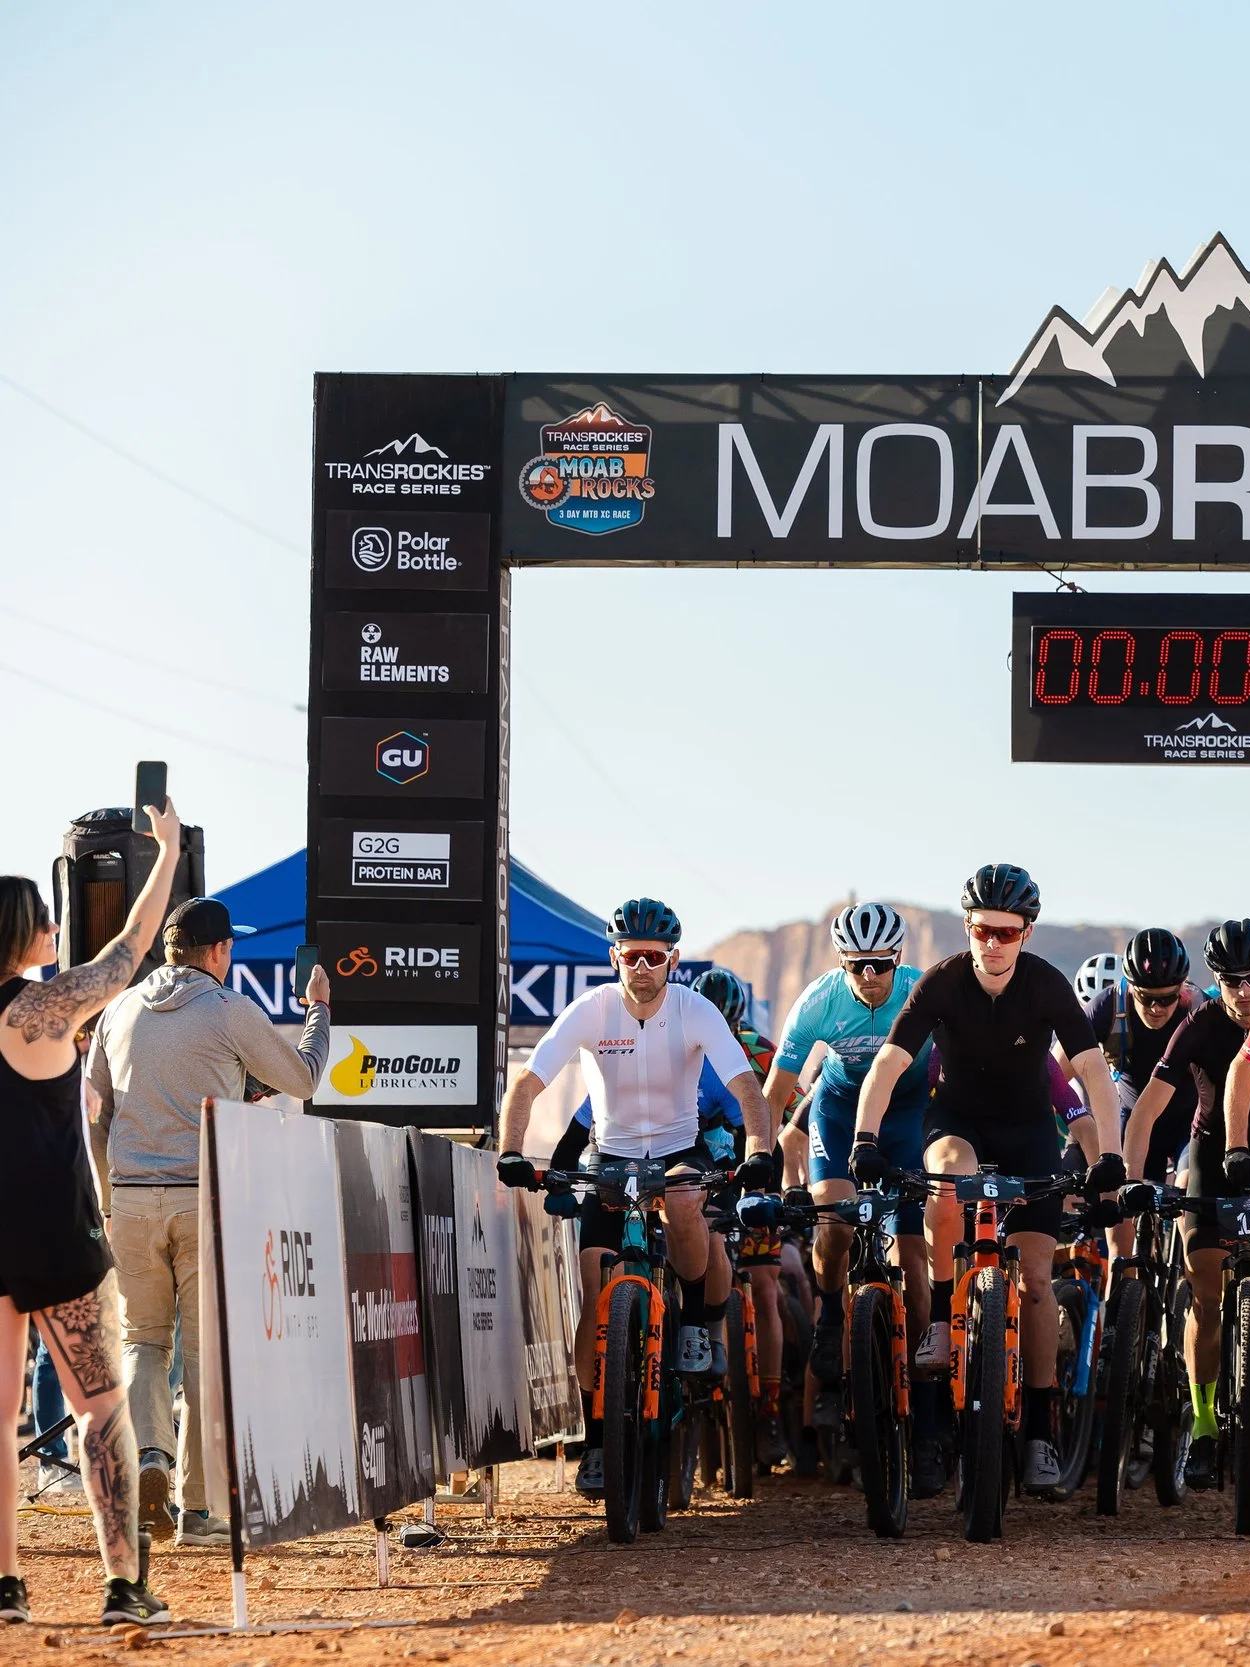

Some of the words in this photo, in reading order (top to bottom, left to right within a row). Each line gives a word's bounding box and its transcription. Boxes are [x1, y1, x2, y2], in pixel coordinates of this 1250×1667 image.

[547, 432, 643, 443] TRANSROCKIES
[593, 444, 629, 452] SERIES
[559, 457, 624, 478] MOAB
[352, 483, 394, 494] RACE
[400, 483, 462, 495] SERIES
[581, 478, 655, 500] ROCKS
[559, 509, 565, 519] 3
[566, 509, 580, 519] DAY
[582, 509, 598, 519] MTB
[600, 509, 611, 519] XC
[612, 510, 631, 519] RACE
[397, 531, 450, 551] Polar
[397, 551, 456, 571] Bottle
[360, 646, 399, 663] RAW
[360, 664, 450, 683] ELEMENTS
[381, 748, 423, 768] GU
[1164, 749, 1197, 759] RACE
[1199, 749, 1246, 759] SERIES
[358, 837, 400, 854] G2G
[358, 866, 414, 880] PROTEIN
[417, 867, 442, 881] BAR
[385, 947, 460, 968] RIDE
[385, 969, 419, 978] WITH
[434, 970, 460, 979] GPS
[598, 1038, 635, 1047] MAXXIS
[360, 1077, 458, 1089] LUBRICANTS
[624, 1175, 640, 1202] 4
[982, 1183, 999, 1199] 6
[858, 1202, 874, 1223] 9
[280, 1230, 316, 1297] RIDE
[352, 1289, 367, 1343] The
